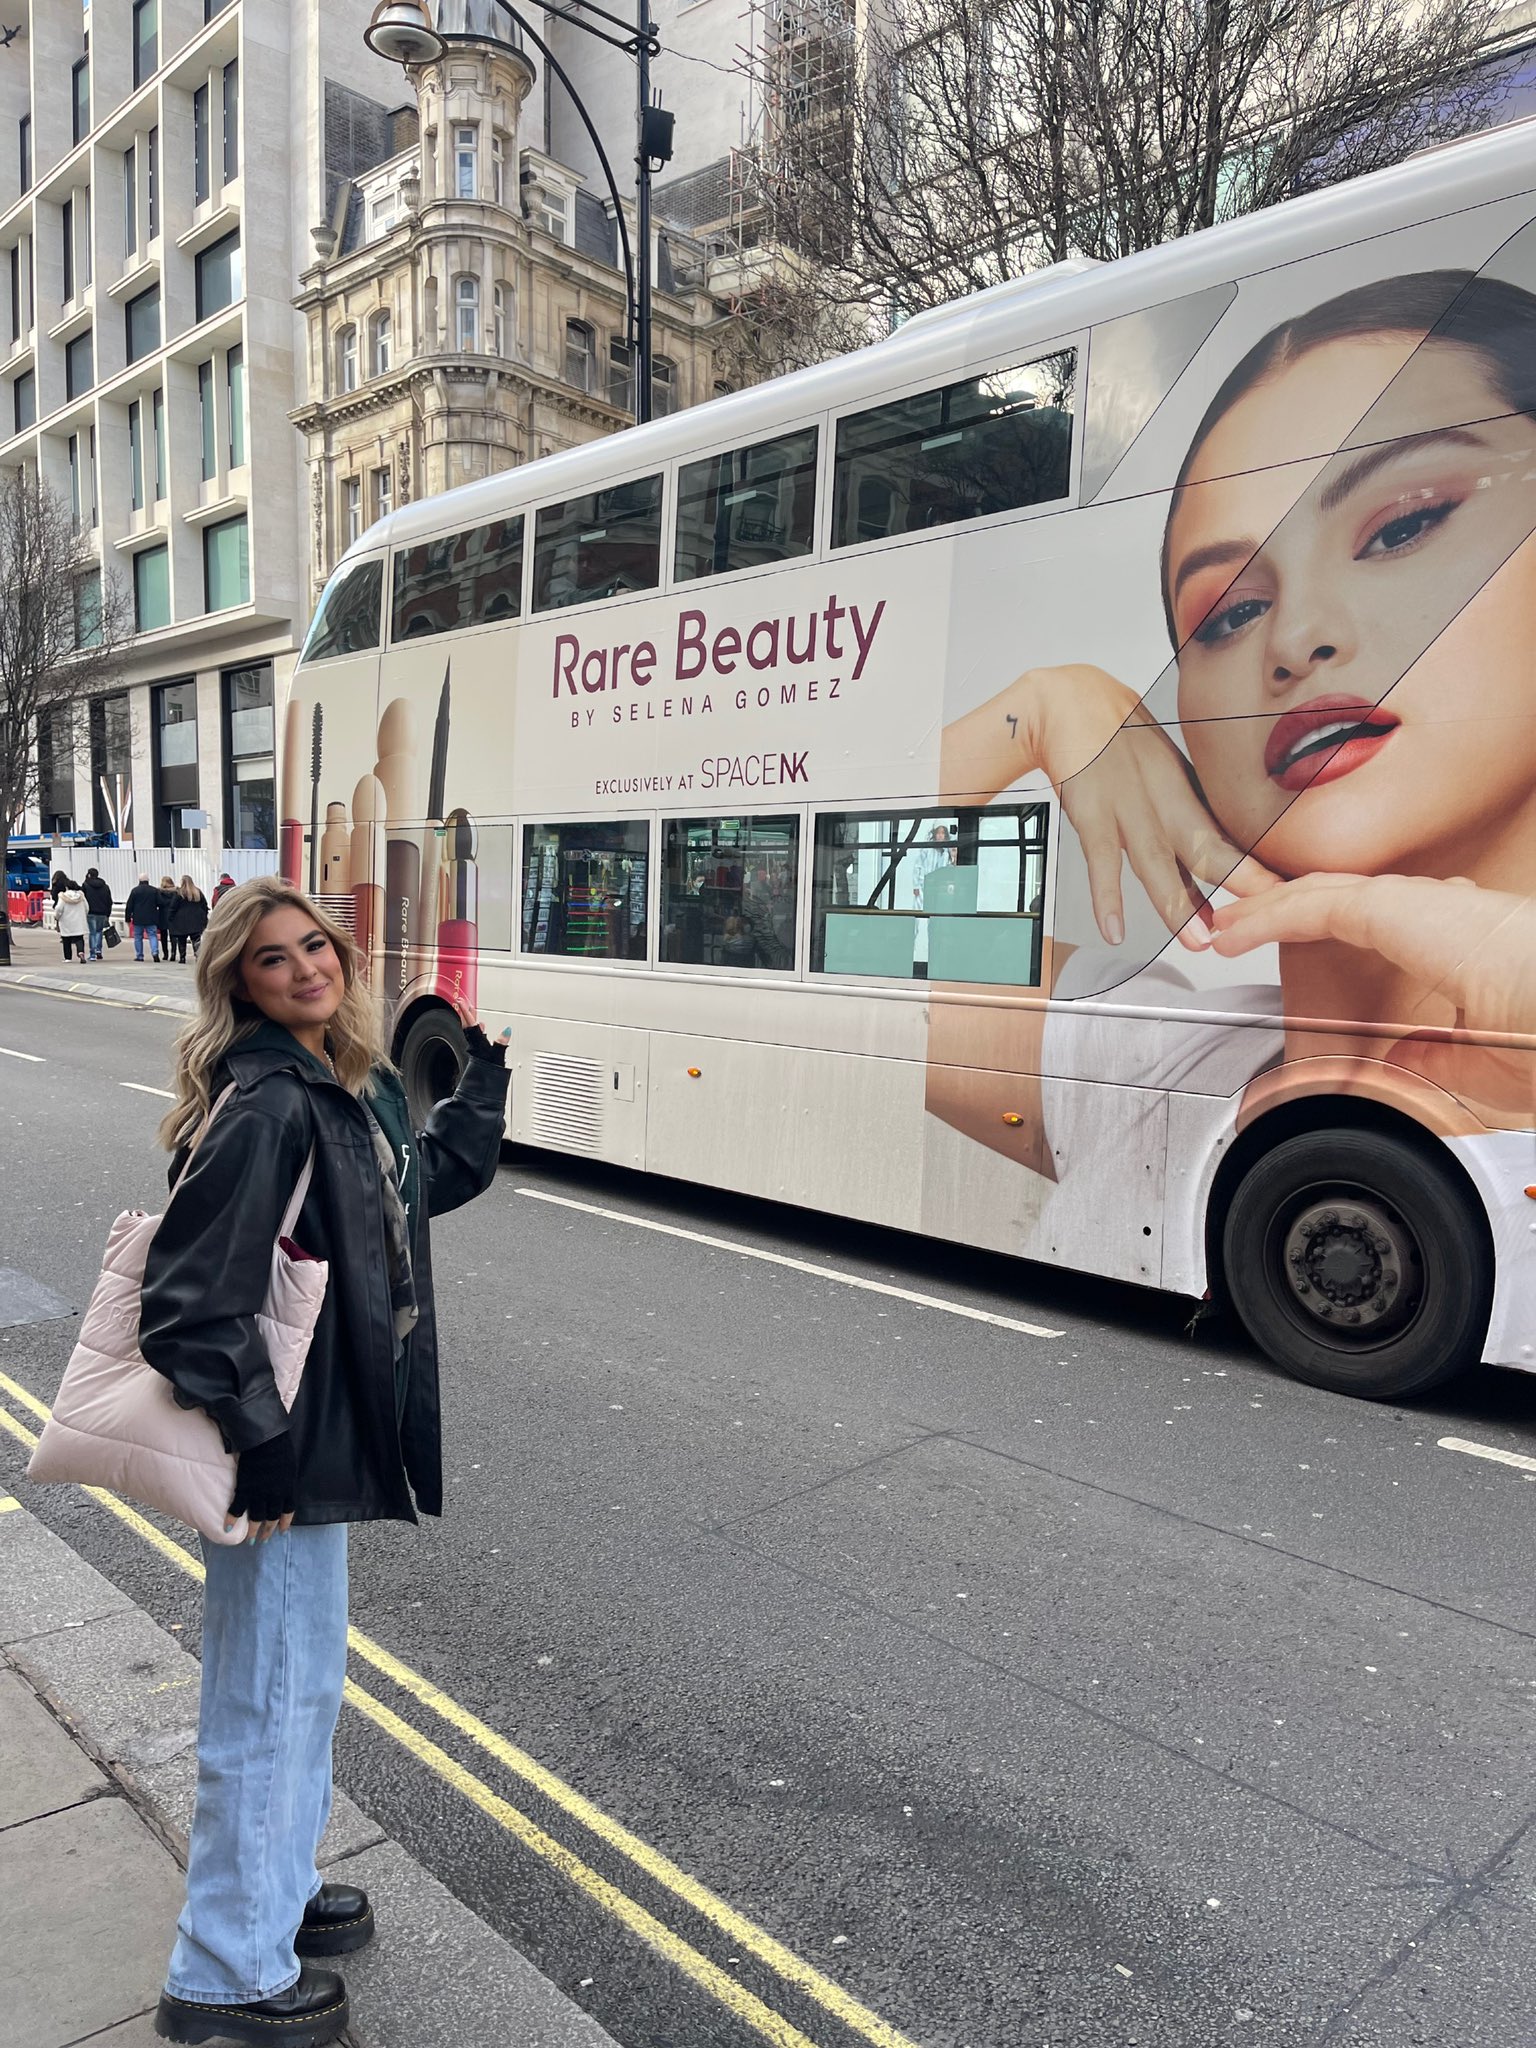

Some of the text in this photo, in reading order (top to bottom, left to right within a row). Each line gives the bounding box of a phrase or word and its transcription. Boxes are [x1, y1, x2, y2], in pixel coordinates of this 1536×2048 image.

[553, 595, 887, 698] Rare Beauty
[571, 678, 840, 728] BY SELENA GOMEZ
[596, 776, 672, 794] EXCLUSIVELY
[678, 775, 693, 790] AT
[399, 937, 409, 994] Beauty
